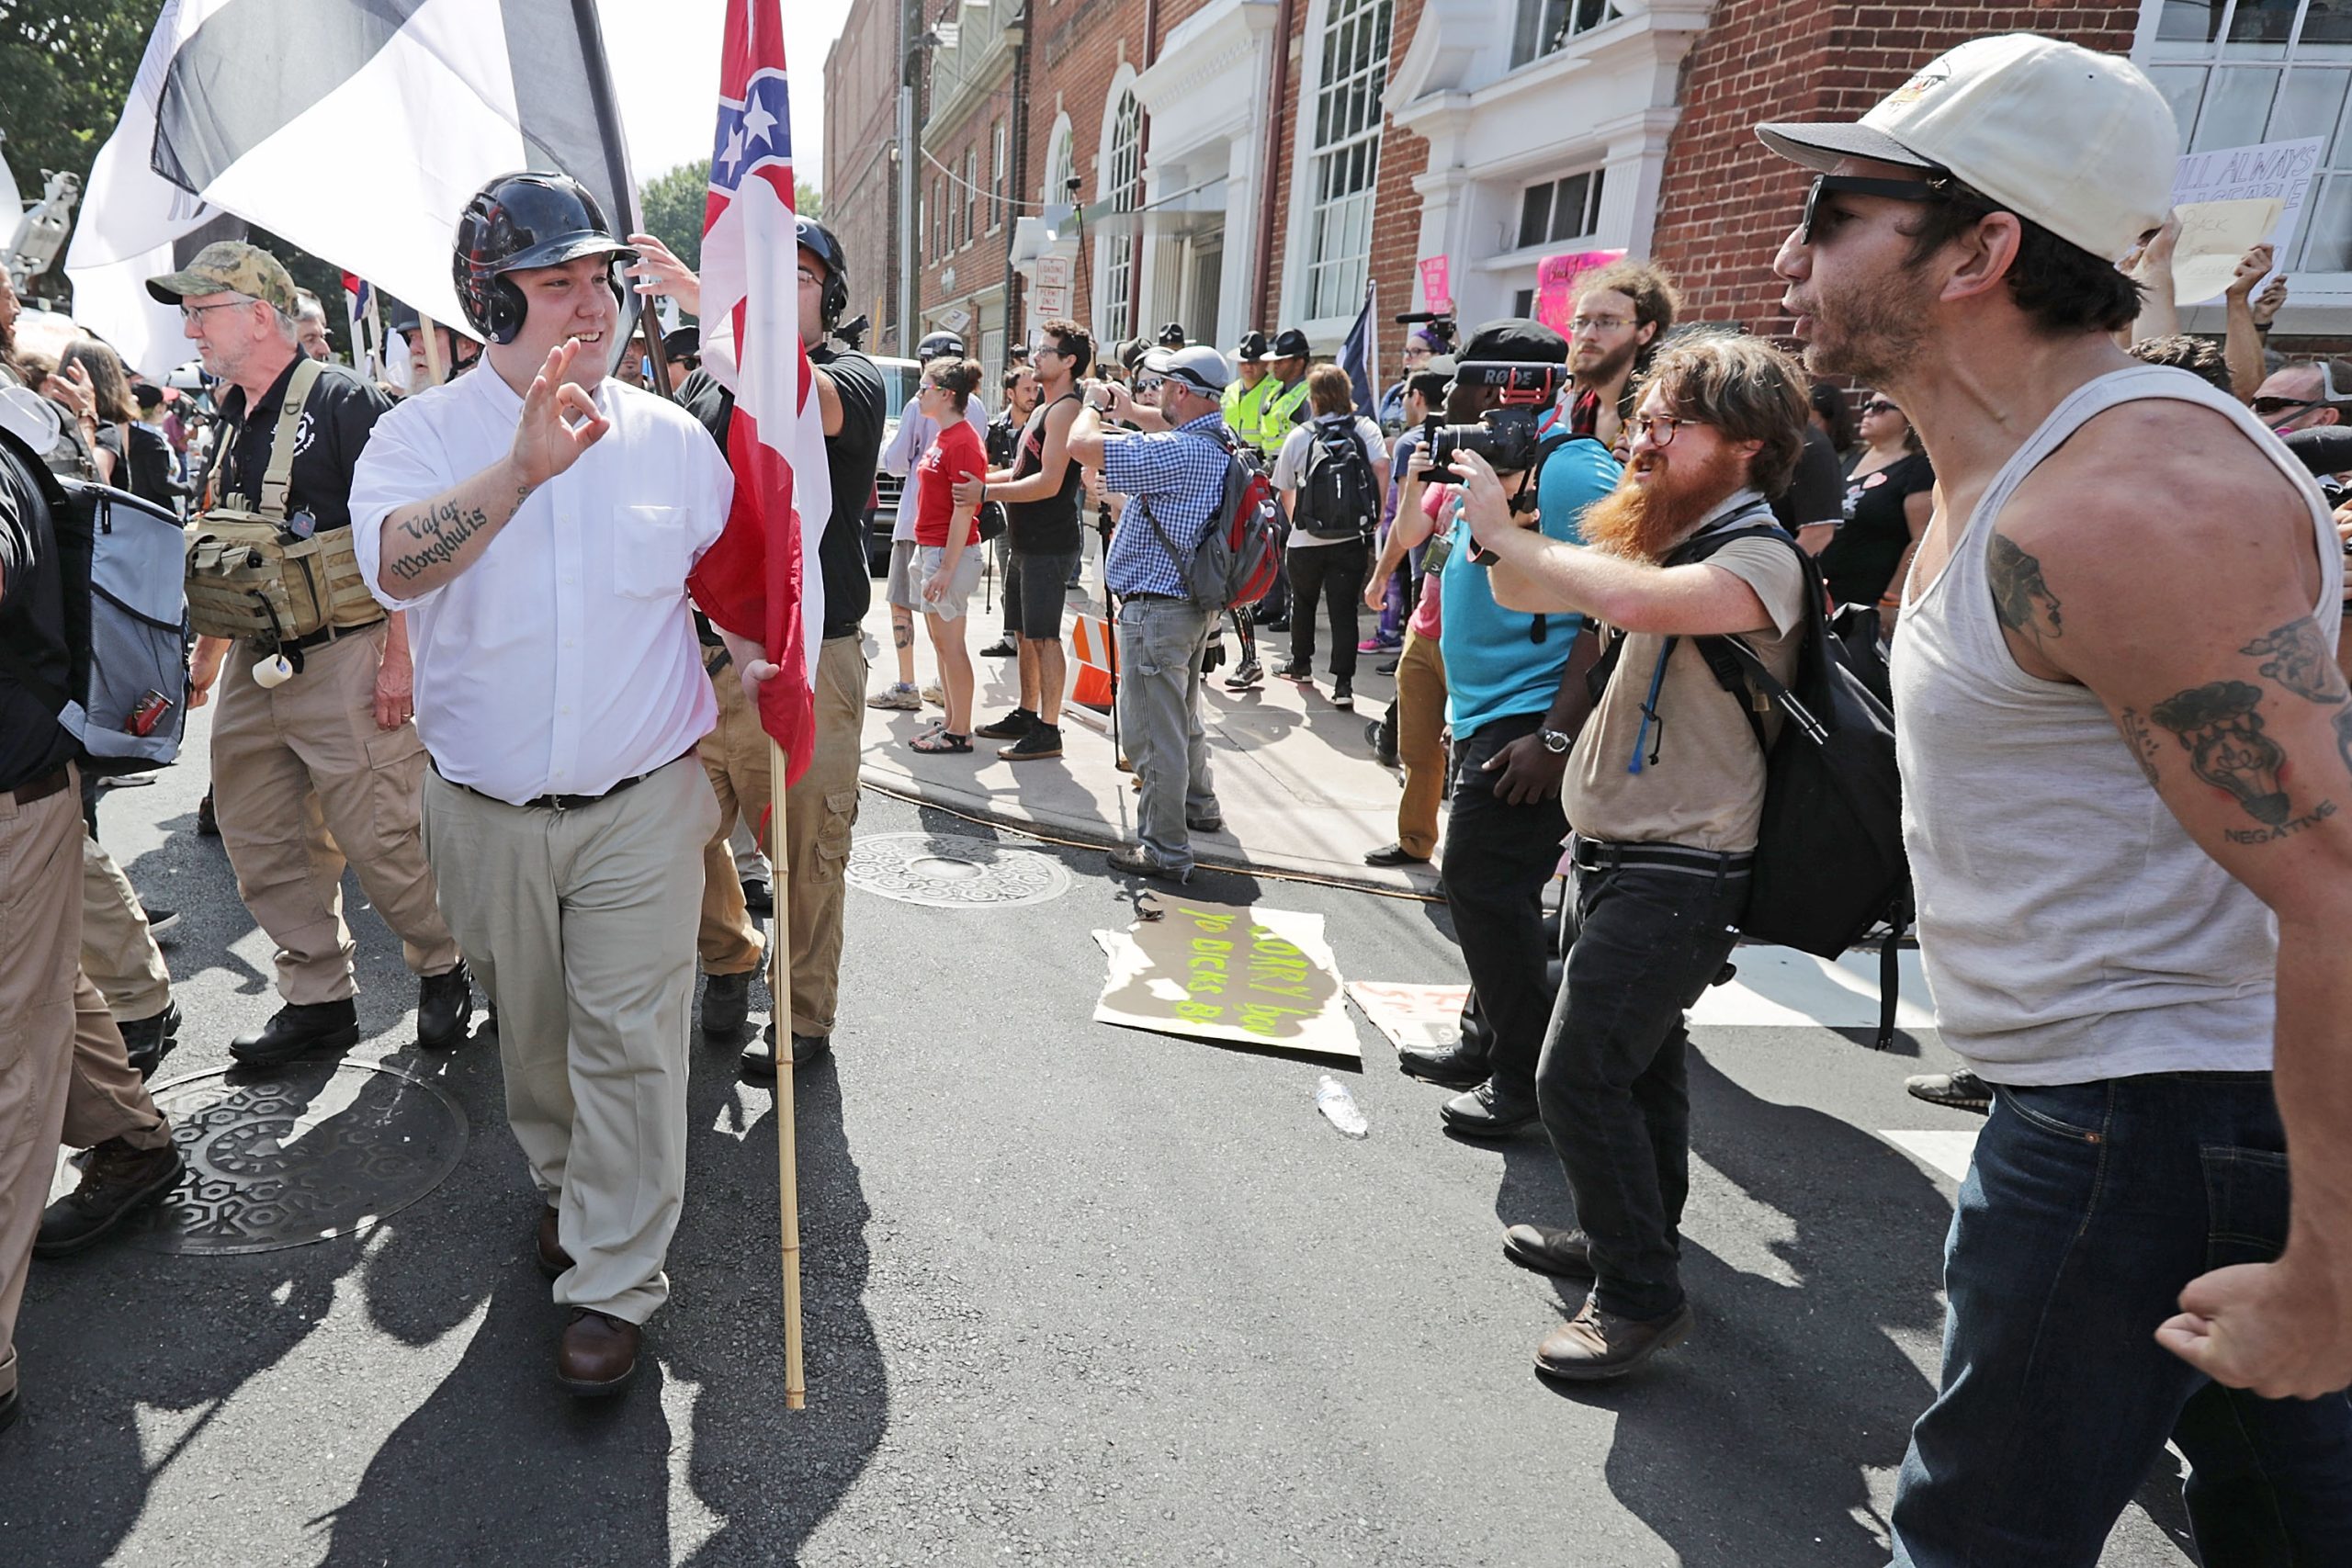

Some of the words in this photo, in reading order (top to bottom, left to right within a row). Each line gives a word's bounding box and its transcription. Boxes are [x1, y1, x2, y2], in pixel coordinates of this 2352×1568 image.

[2215, 145, 2316, 185] ALWAYS
[1039, 265, 1064, 274] LOADING
[1044, 276, 1058, 285] ZONE
[1040, 288, 1060, 297] PERMIT
[1042, 297, 1057, 305] ONLY
[397, 497, 459, 540] Valar
[390, 506, 487, 580] Morghulis
[2224, 798, 2338, 844] NEGATIVE
[1186, 938, 1234, 994] DICKS
